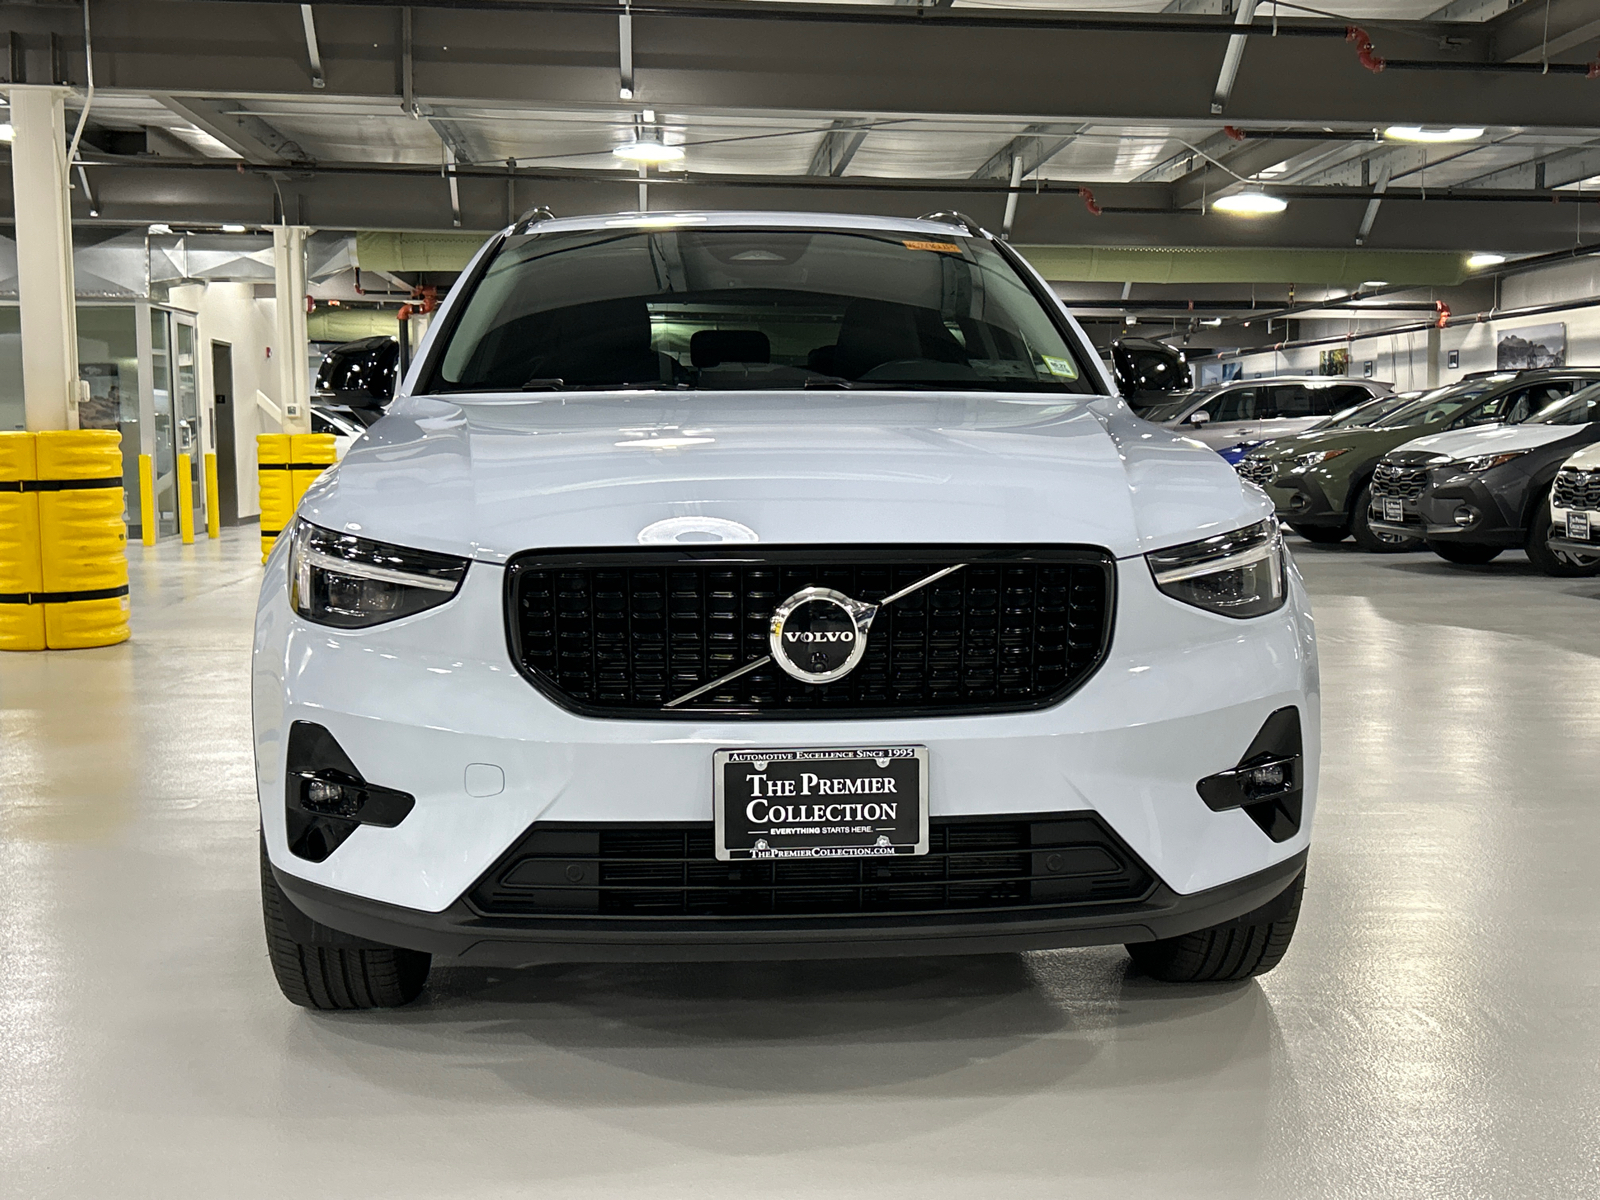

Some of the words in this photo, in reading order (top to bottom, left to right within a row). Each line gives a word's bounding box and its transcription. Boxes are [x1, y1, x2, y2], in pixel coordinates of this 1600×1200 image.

[784, 631, 854, 642] VOLVO
[730, 752, 794, 761] AUTOMOTIVE
[796, 750, 854, 760] EXCELLENCE
[856, 749, 885, 758] SINCE
[887, 748, 914, 757] 1995
[746, 773, 796, 797] THE
[799, 773, 898, 796] PREMIER
[746, 798, 898, 823] COLLECTION
[770, 827, 820, 835] EVERYTHING
[821, 826, 850, 834] STARTS
[851, 825, 874, 833] HERE.
[749, 846, 895, 858] THEPREMIERCOLLECTION.COM
